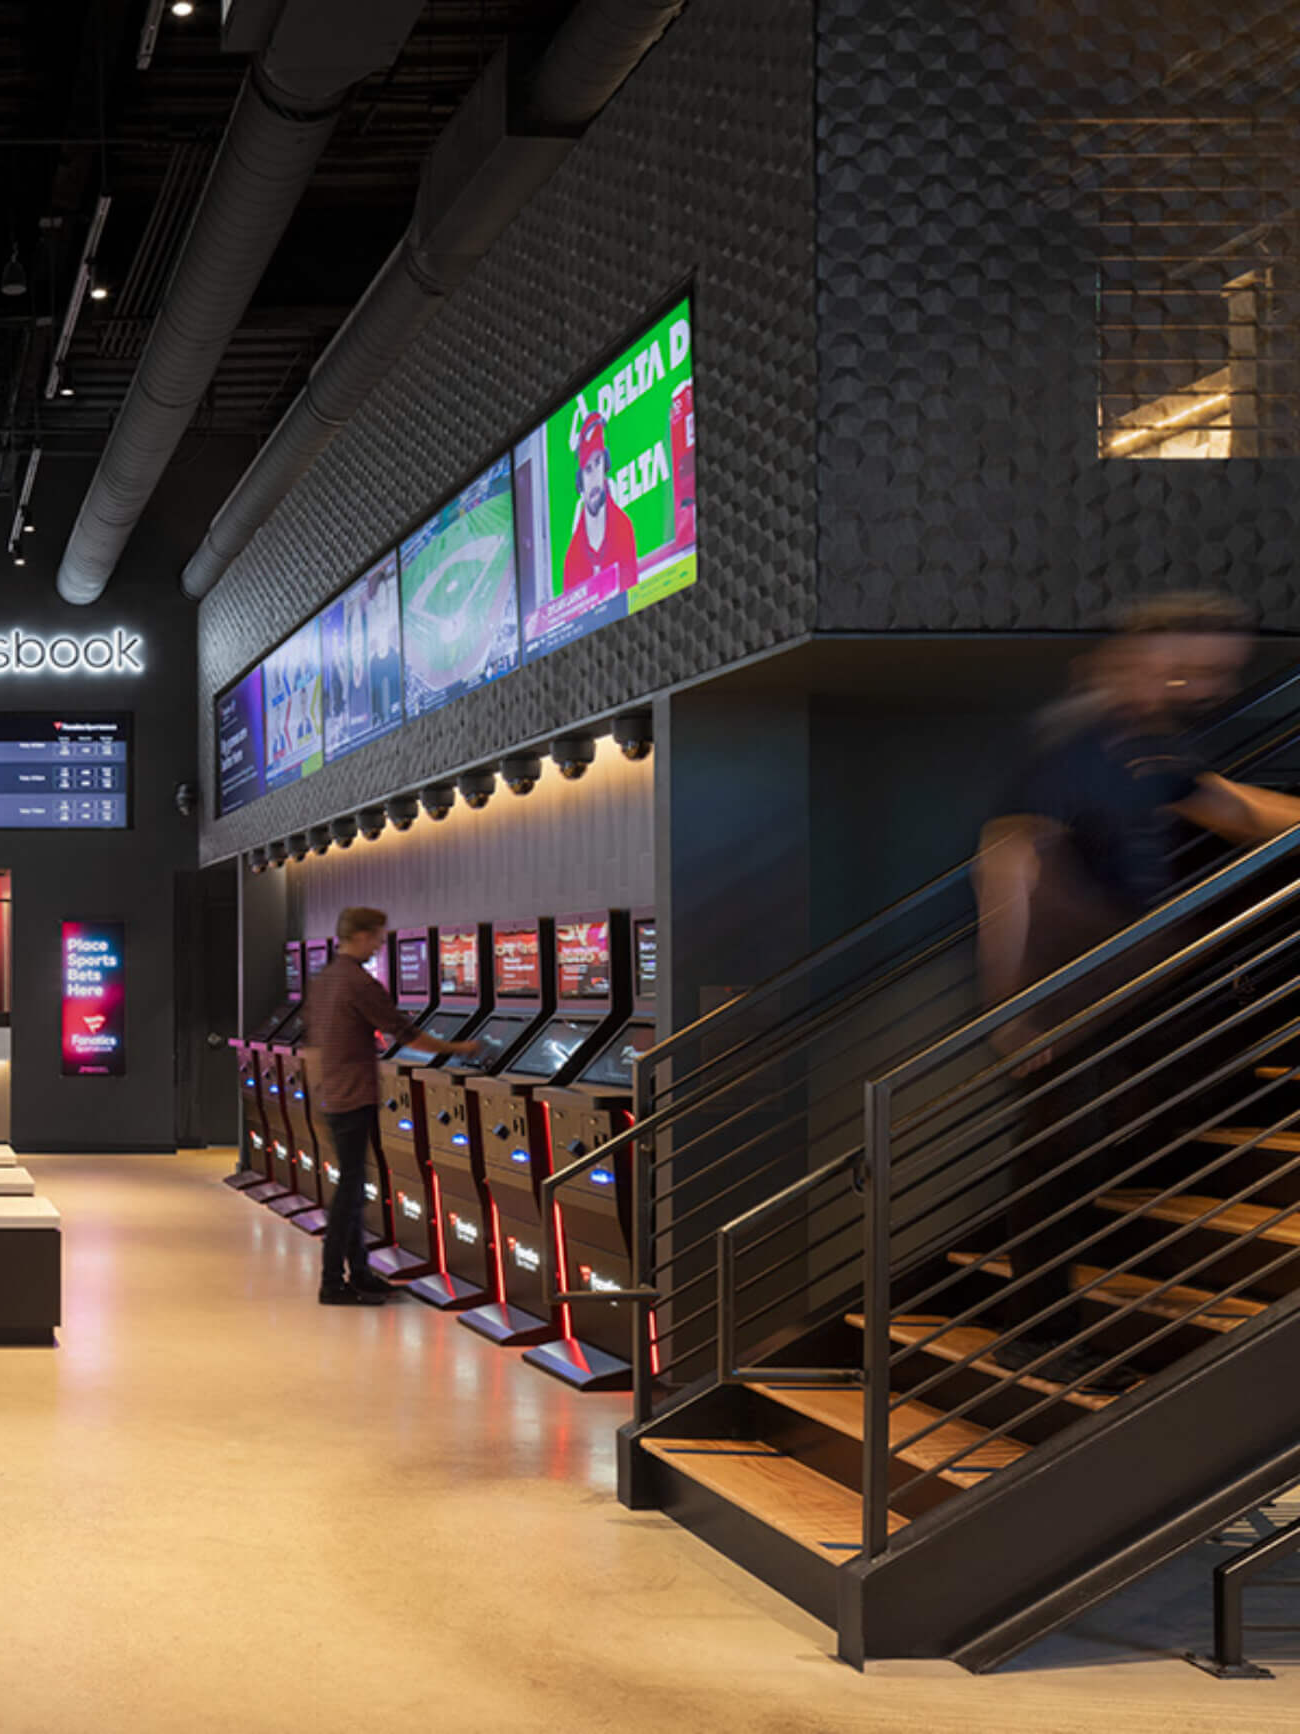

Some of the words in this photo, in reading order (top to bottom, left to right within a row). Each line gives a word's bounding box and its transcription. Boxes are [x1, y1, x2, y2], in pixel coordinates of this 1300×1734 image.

[598, 340, 665, 423] DELTA
[67, 938, 109, 951] Place
[67, 953, 117, 968] Sports
[67, 969, 102, 981] Bets
[67, 984, 103, 996] Here
